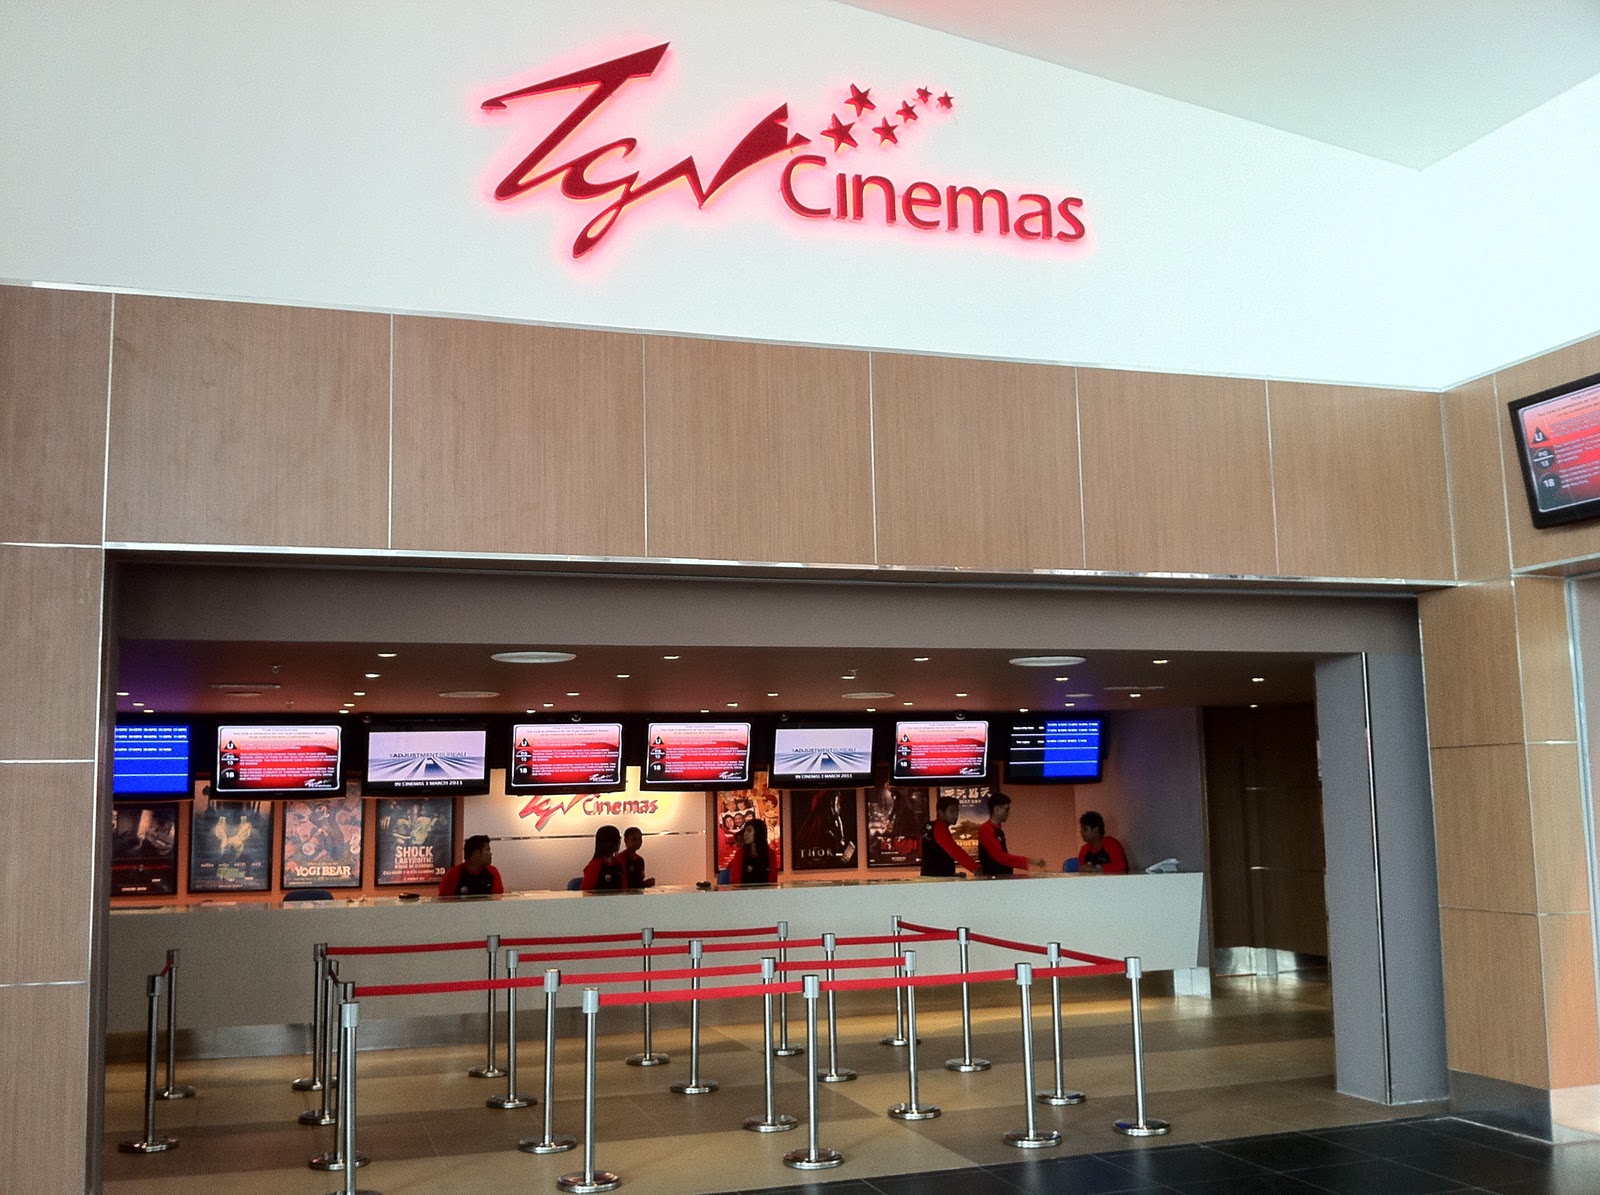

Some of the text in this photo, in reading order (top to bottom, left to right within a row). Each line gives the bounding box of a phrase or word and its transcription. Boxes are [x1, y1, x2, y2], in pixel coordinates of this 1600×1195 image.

[780, 153, 1086, 242] Cinemas
[1535, 432, 1544, 441] U
[1543, 478, 1555, 488] 18
[582, 797, 659, 815] Cinemas
[395, 845, 434, 858] SHOCK
[800, 848, 834, 858] THOR
[295, 865, 351, 877] YOGI BEAR
[435, 867, 446, 875] 3D
